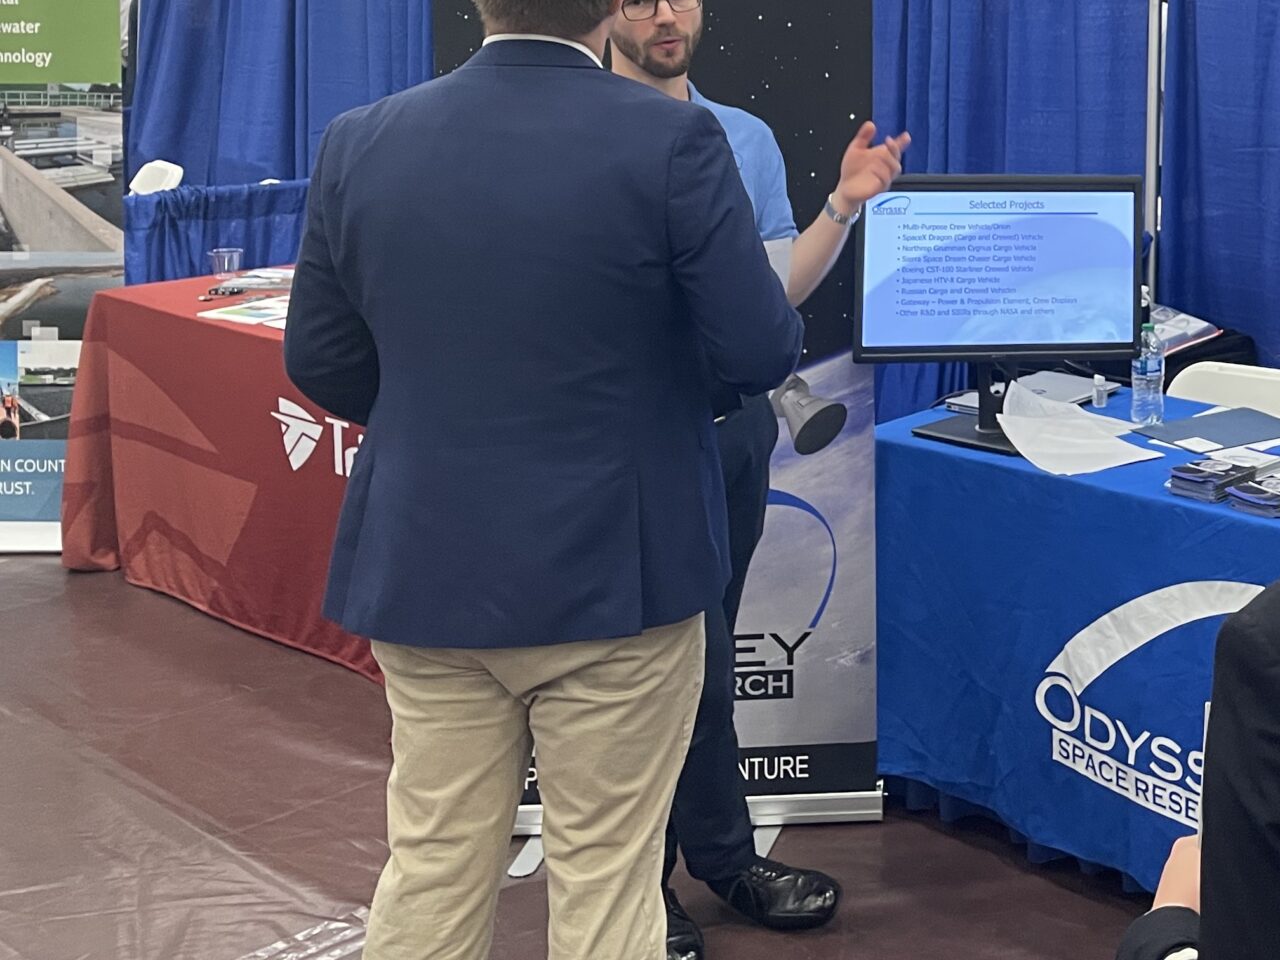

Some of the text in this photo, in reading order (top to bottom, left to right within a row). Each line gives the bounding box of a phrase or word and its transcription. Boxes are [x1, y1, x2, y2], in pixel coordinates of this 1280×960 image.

[0, 20, 41, 34] water
[969, 200, 1045, 210] Selected Projects
[1058, 737, 1130, 793] SPACE
